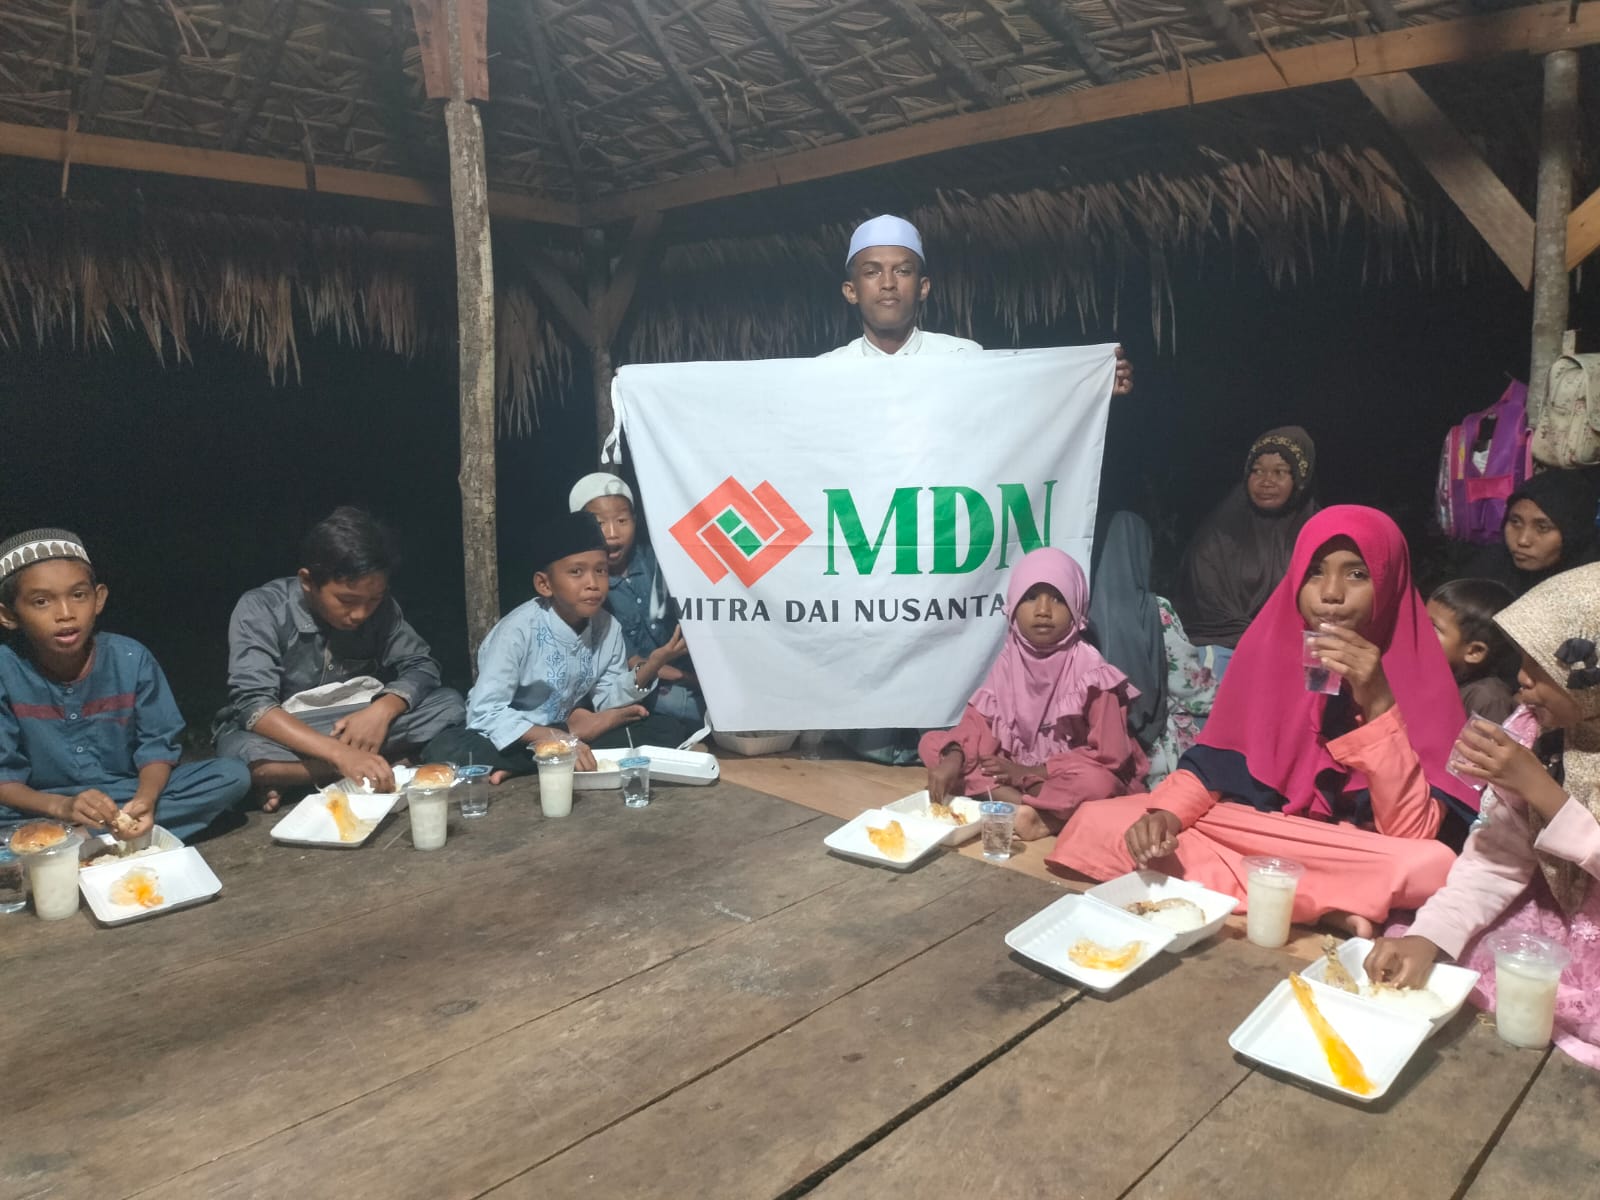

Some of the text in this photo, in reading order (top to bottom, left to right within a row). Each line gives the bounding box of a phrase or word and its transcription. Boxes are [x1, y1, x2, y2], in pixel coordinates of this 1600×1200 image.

[823, 480, 1058, 575] MDN
[671, 593, 1006, 623] MITRA DAI NUSANTA
